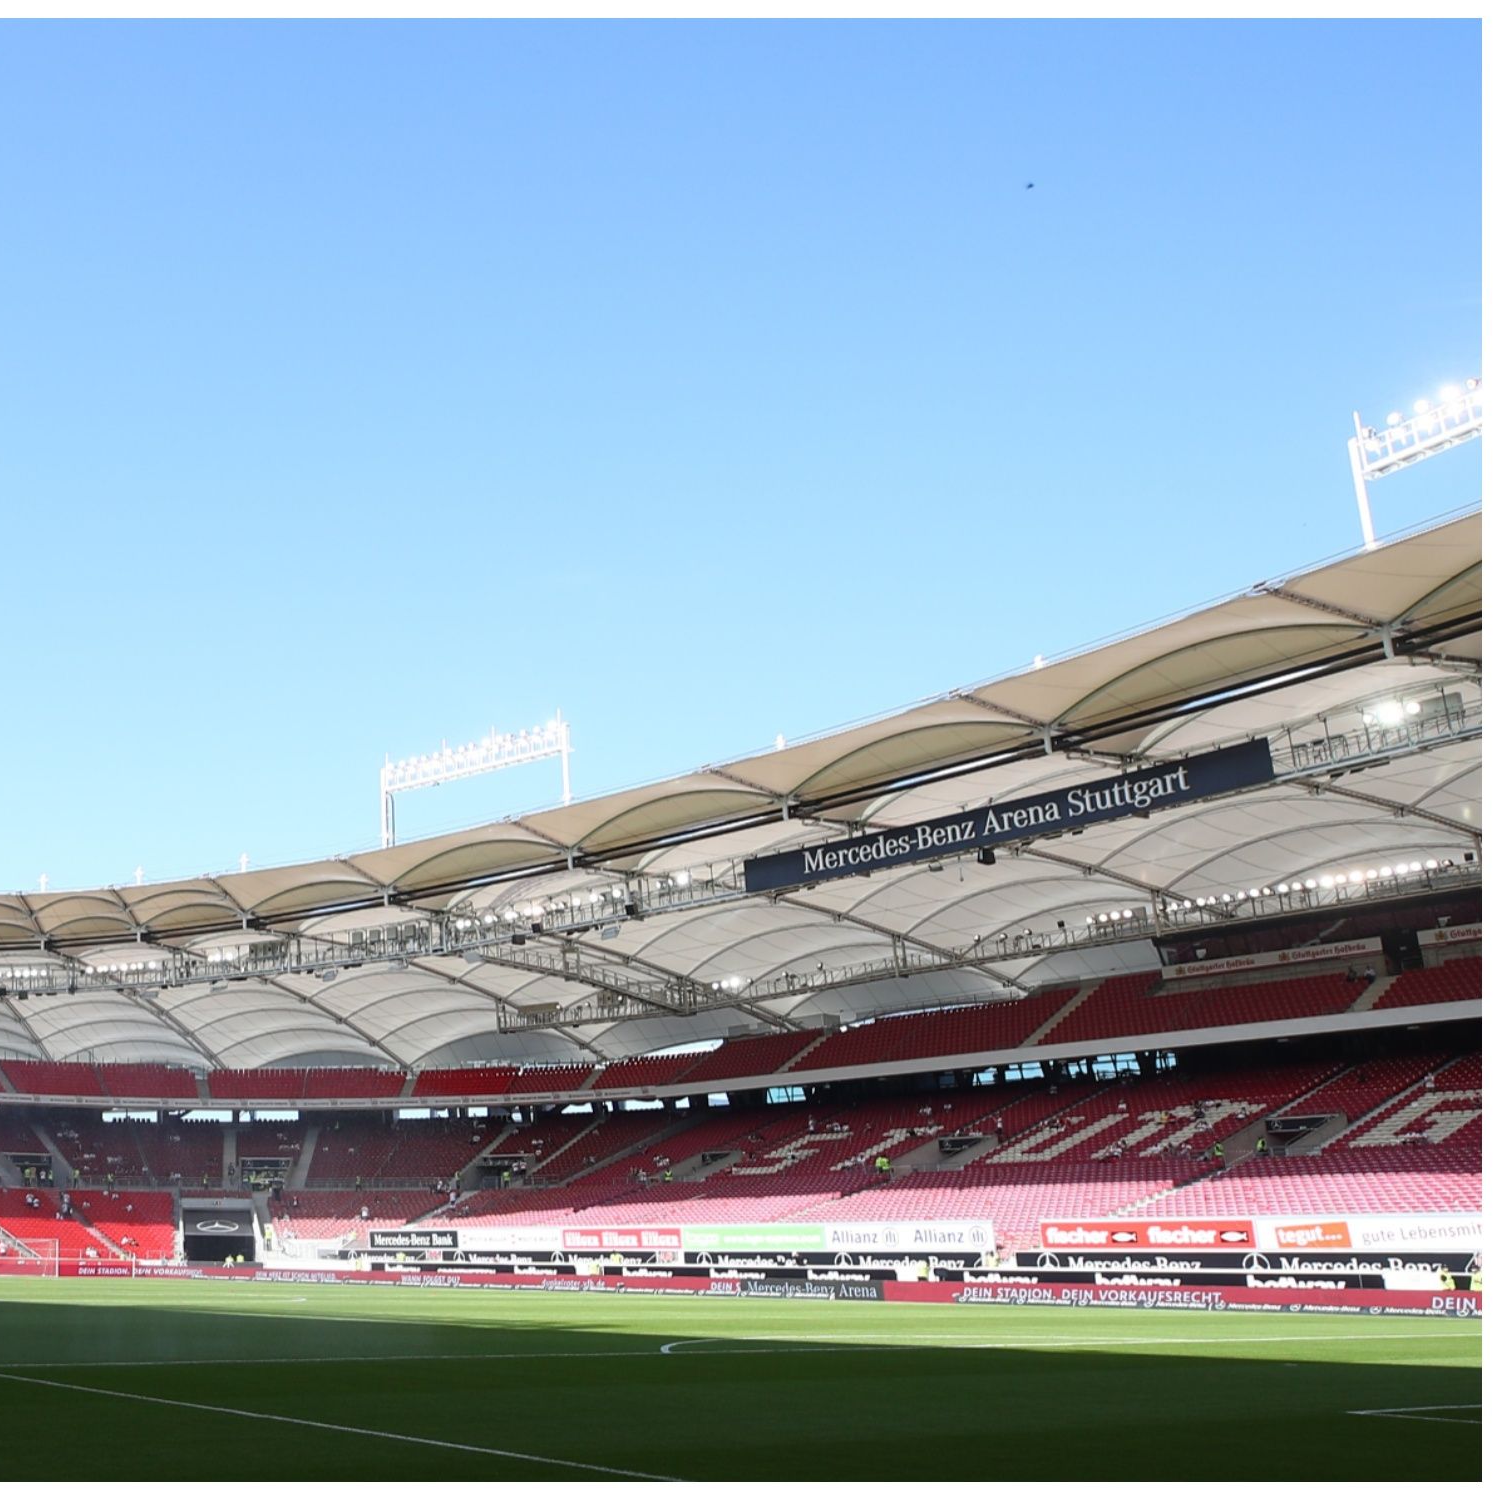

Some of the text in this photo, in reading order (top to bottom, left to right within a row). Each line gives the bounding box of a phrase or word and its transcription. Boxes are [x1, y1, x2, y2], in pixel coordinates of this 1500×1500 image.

[803, 765, 1191, 874] Mercedes-Benz Arena Stuttgart
[373, 1233, 453, 1246] Mercedes-Benz Bank
[832, 1230, 878, 1243] Allianz
[914, 1229, 964, 1243] Allianz
[1046, 1227, 1109, 1244] fischer
[1147, 1225, 1216, 1244] fischer
[1362, 1229, 1395, 1245] gute
[711, 1282, 732, 1291] DEIN
[747, 1281, 834, 1295] Mercedes-Benz
[839, 1283, 877, 1298] Arena
[964, 1287, 1224, 1304] DEIN STADION. DEIN VORKAUFSRECHT.
[1432, 1296, 1476, 1310] DEIN
